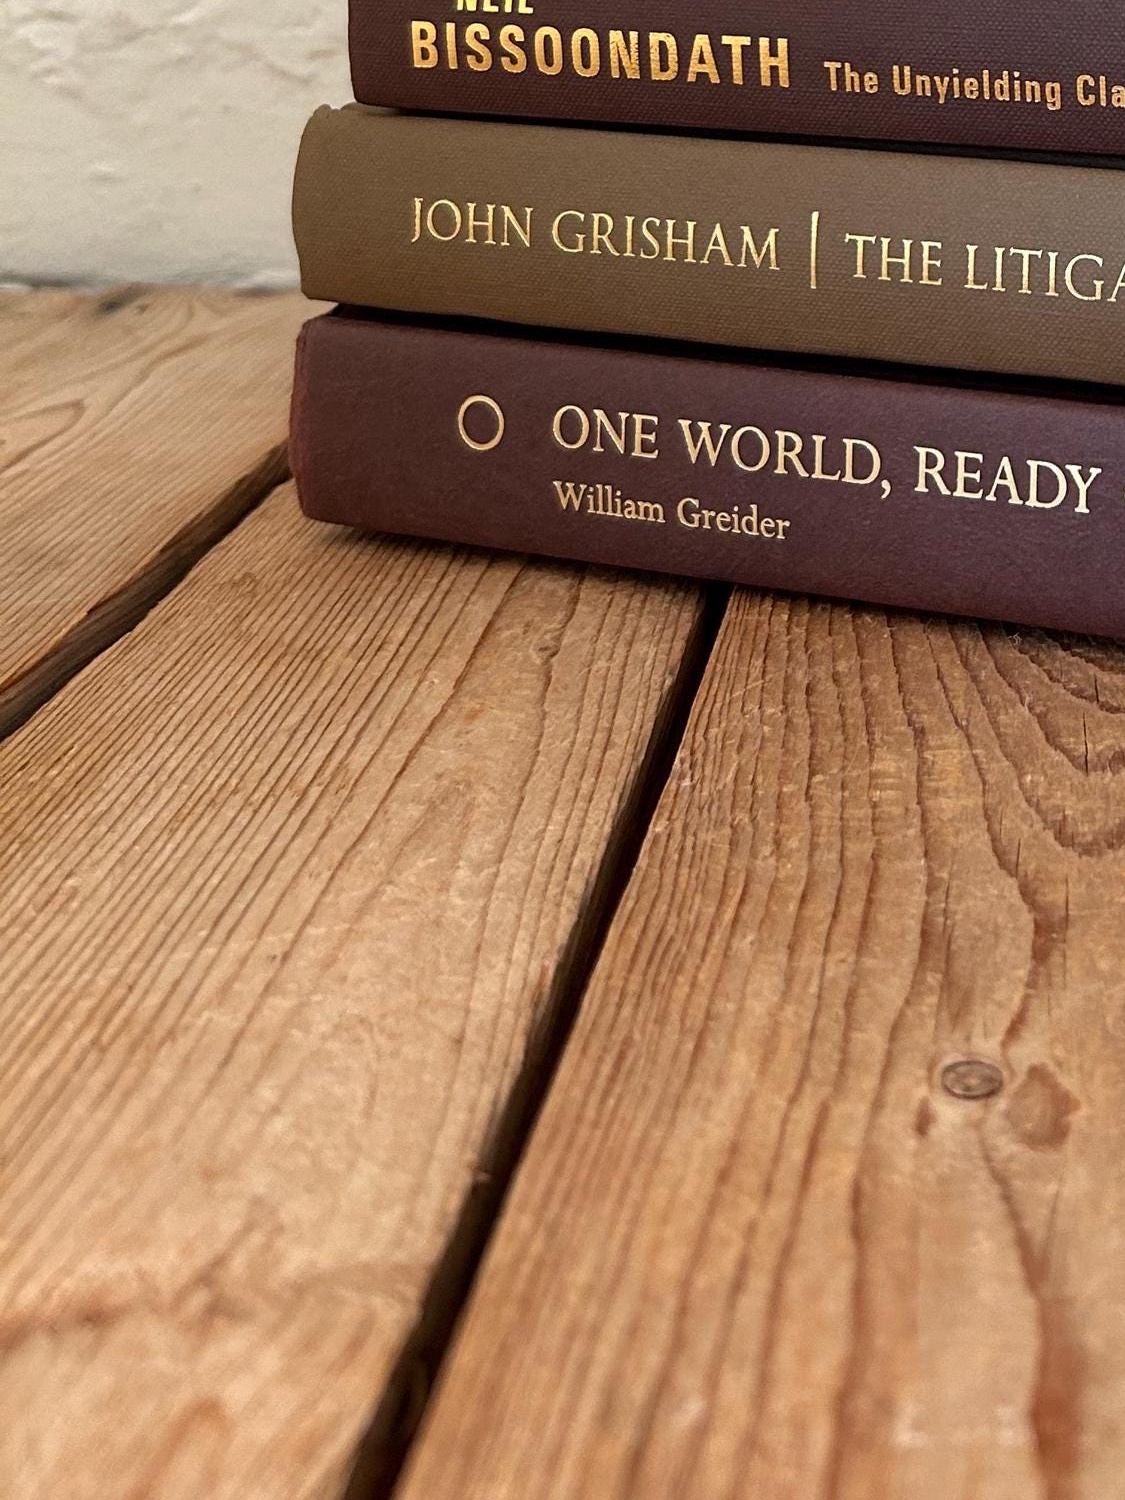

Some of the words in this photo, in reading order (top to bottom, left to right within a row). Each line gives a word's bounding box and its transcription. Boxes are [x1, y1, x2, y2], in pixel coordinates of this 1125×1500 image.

[409, 20, 791, 89] BISSOONDATH
[822, 60, 879, 95] The
[892, 64, 1063, 112] Unyielding
[409, 196, 534, 248] JOHN
[551, 210, 782, 271] GRISHAM
[842, 232, 944, 286] THE
[551, 404, 660, 460] ONE
[676, 418, 893, 500] WORLD,
[911, 445, 1103, 515] READY
[551, 480, 666, 524] William
[676, 497, 792, 541] Greider
